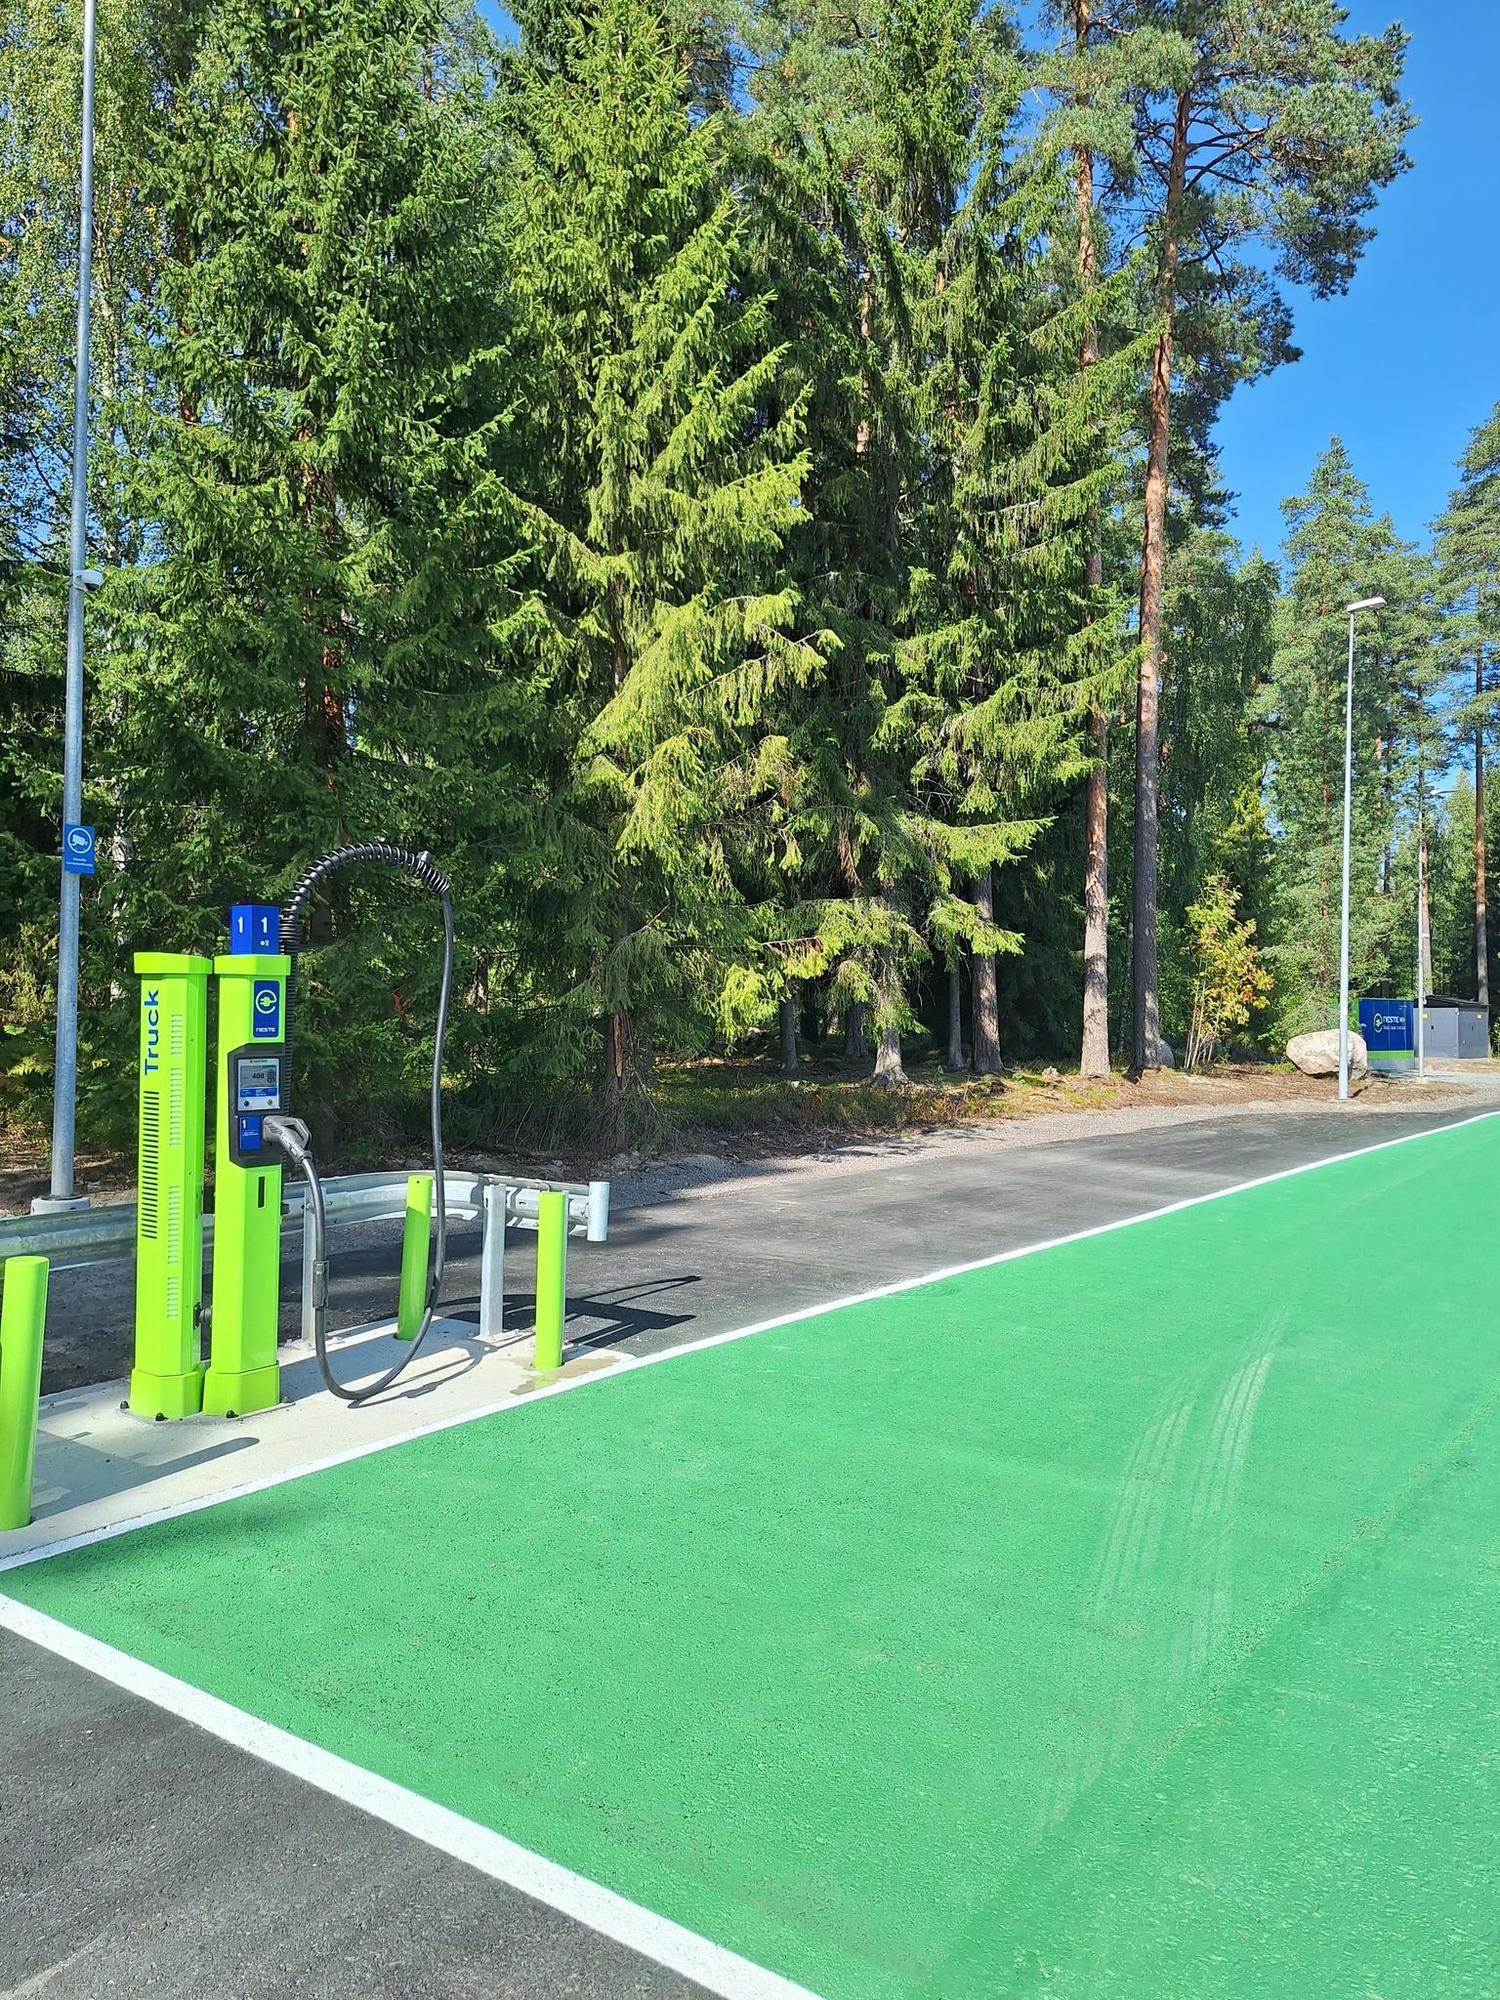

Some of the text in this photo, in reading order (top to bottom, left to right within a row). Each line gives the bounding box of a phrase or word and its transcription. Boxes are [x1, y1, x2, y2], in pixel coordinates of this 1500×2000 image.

[238, 916, 244, 934] 1
[261, 916, 268, 934] 1
[144, 989, 159, 1076] Truck
[242, 1119, 247, 1129] 1
